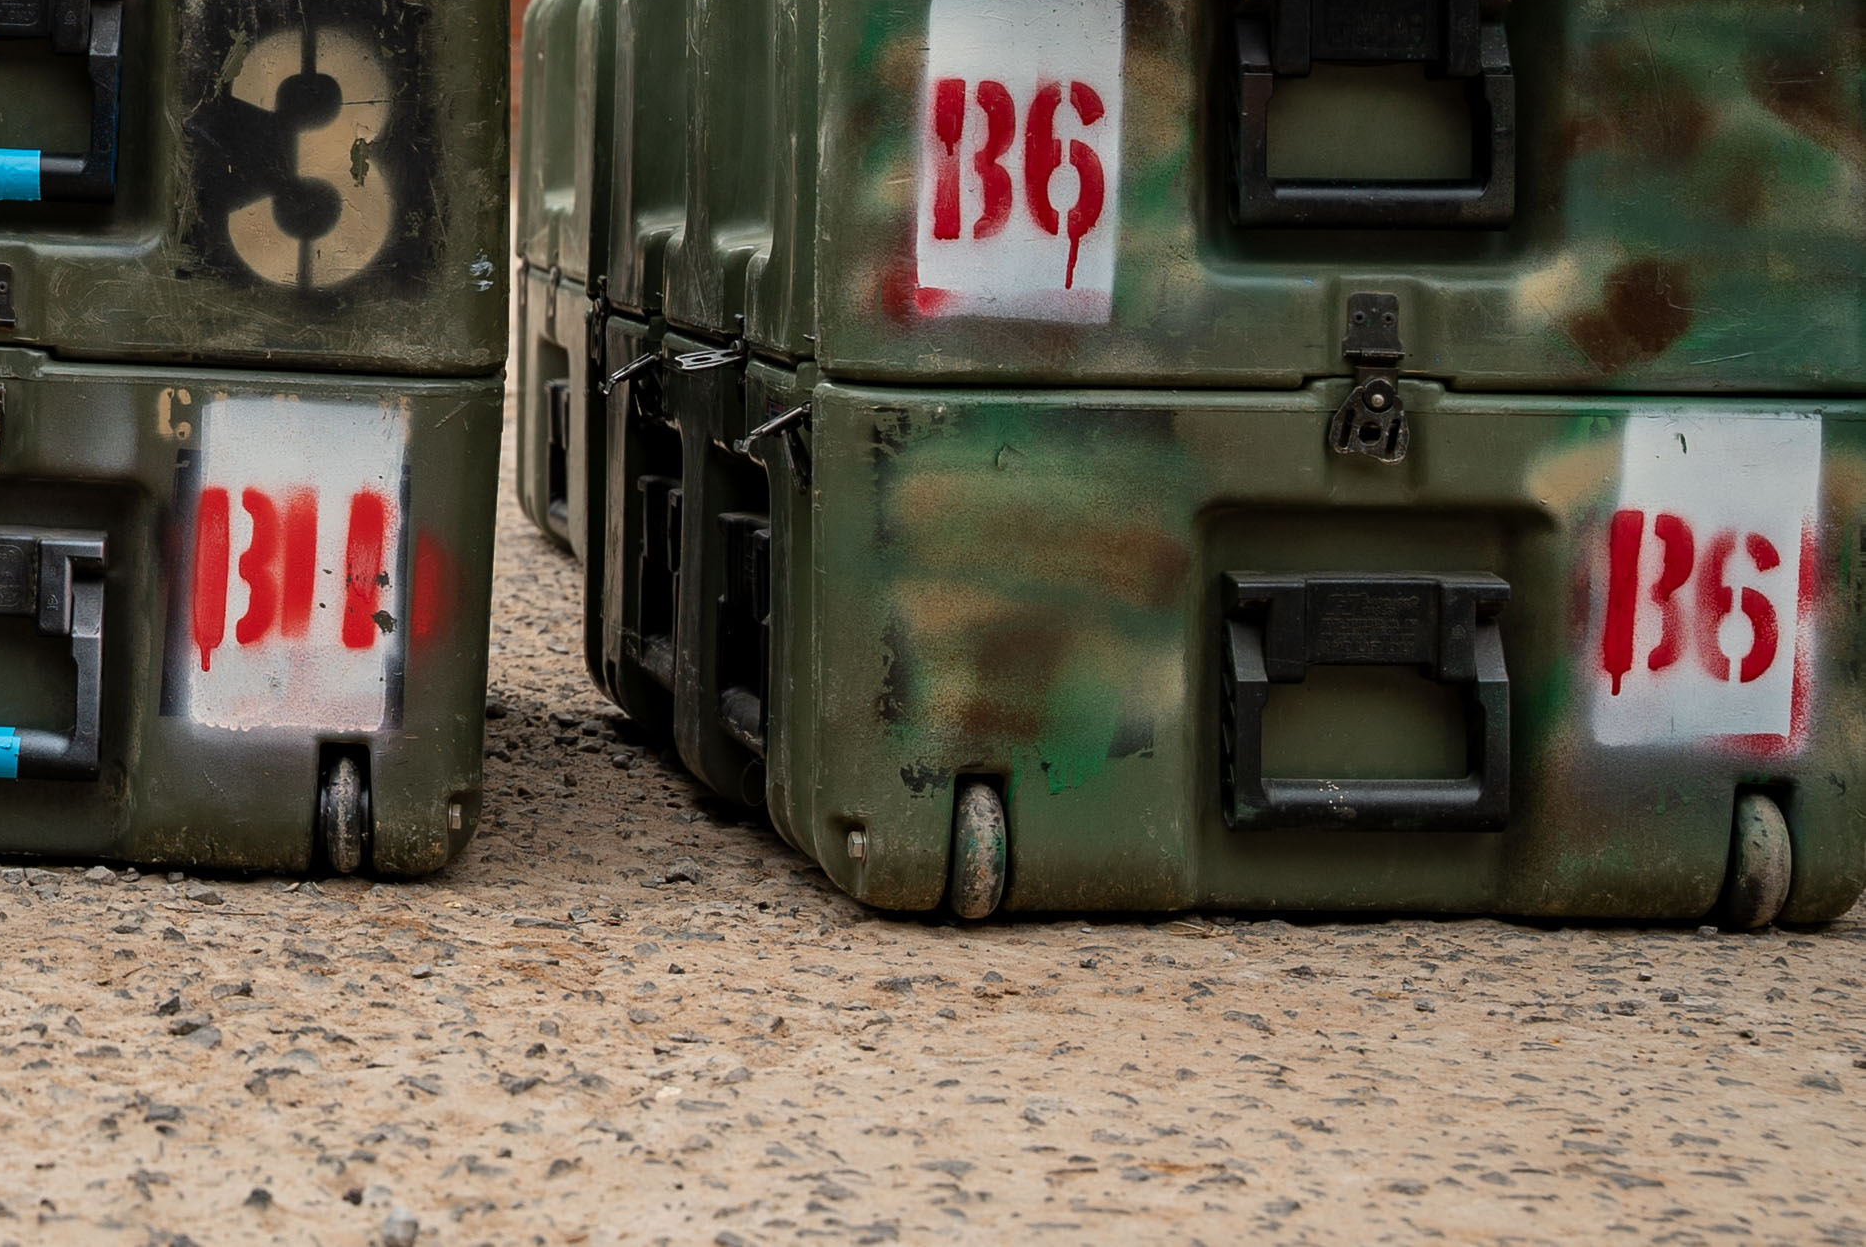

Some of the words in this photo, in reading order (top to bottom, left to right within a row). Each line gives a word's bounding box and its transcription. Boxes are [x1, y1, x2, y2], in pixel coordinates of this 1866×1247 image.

[228, 26, 392, 289] 3
[930, 77, 1106, 244] B6
[1600, 508, 1782, 684] B6
